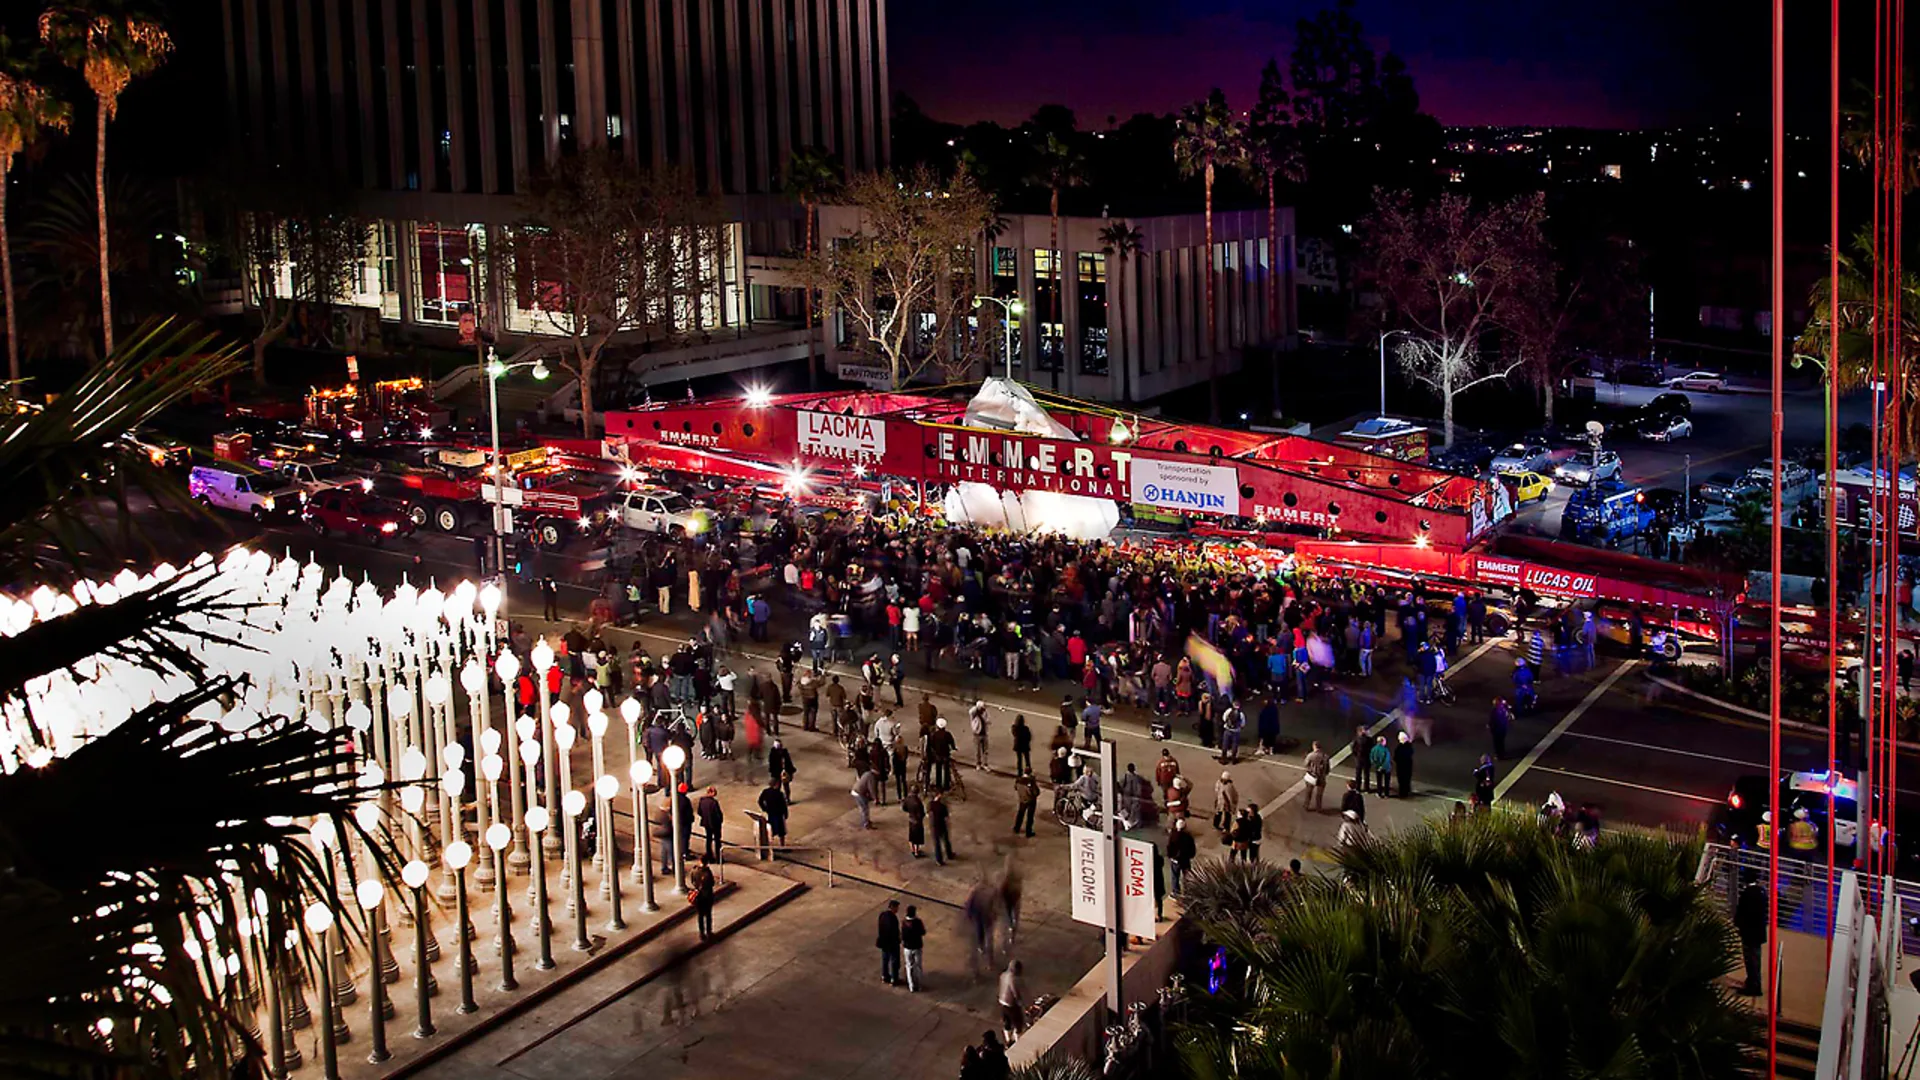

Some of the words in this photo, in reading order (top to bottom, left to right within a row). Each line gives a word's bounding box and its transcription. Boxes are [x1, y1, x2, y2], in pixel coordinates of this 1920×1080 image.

[809, 413, 874, 441] LACMA
[660, 430, 719, 446] EMMERT
[800, 442, 883, 464] EMMERT
[1157, 463, 1212, 475] Transportation
[939, 463, 1130, 498] INTERNATIONAL
[1159, 473, 1198, 484] sponsored
[1199, 477, 1210, 487] by
[1161, 488, 1225, 508] HANJIN
[1254, 504, 1339, 524] EMMERT
[1477, 560, 1520, 574] EMMERT
[1525, 569, 1571, 588] LUCAS
[1572, 577, 1594, 592] OIL
[1081, 838, 1096, 906] WELCOME
[1130, 849, 1145, 897] LACMA
